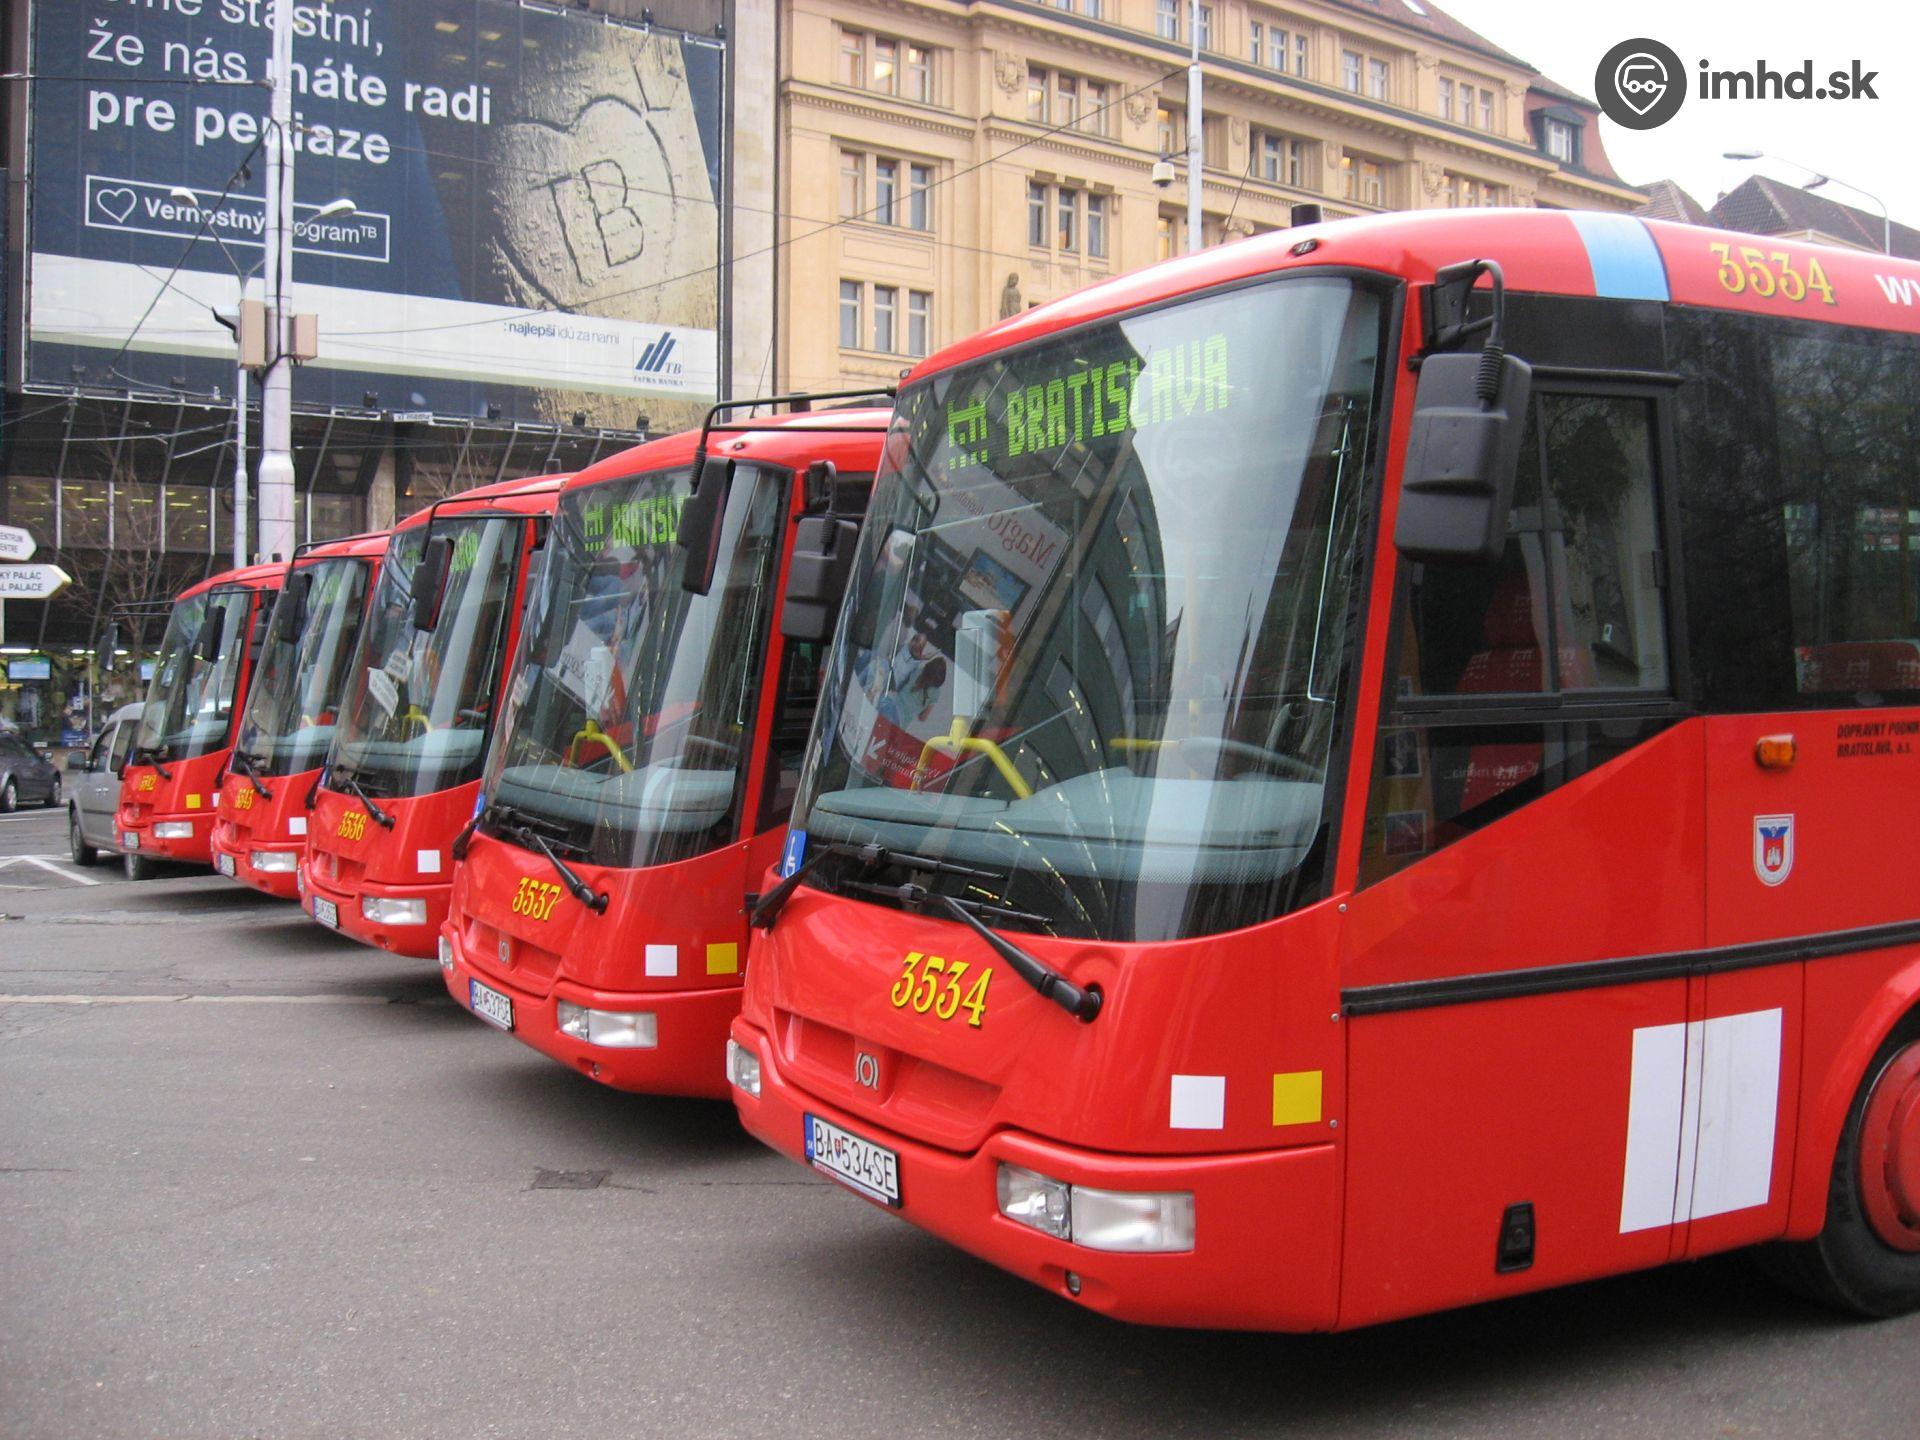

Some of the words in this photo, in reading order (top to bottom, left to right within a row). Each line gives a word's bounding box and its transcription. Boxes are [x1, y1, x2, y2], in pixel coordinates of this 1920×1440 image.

[87, 18, 146, 67] že
[163, 37, 249, 82] nás
[404, 82, 492, 125] radi
[88, 90, 177, 132] pre
[144, 196, 266, 237] Vernostný
[1709, 242, 1839, 307] 3534
[591, 332, 620, 345] nami
[664, 361, 683, 375] TB
[1006, 332, 1229, 458] BRATISLAVA
[9, 583, 43, 592] PALACE
[337, 811, 368, 841] 3536
[511, 876, 562, 921] 3537
[890, 950, 993, 1028] 3534
